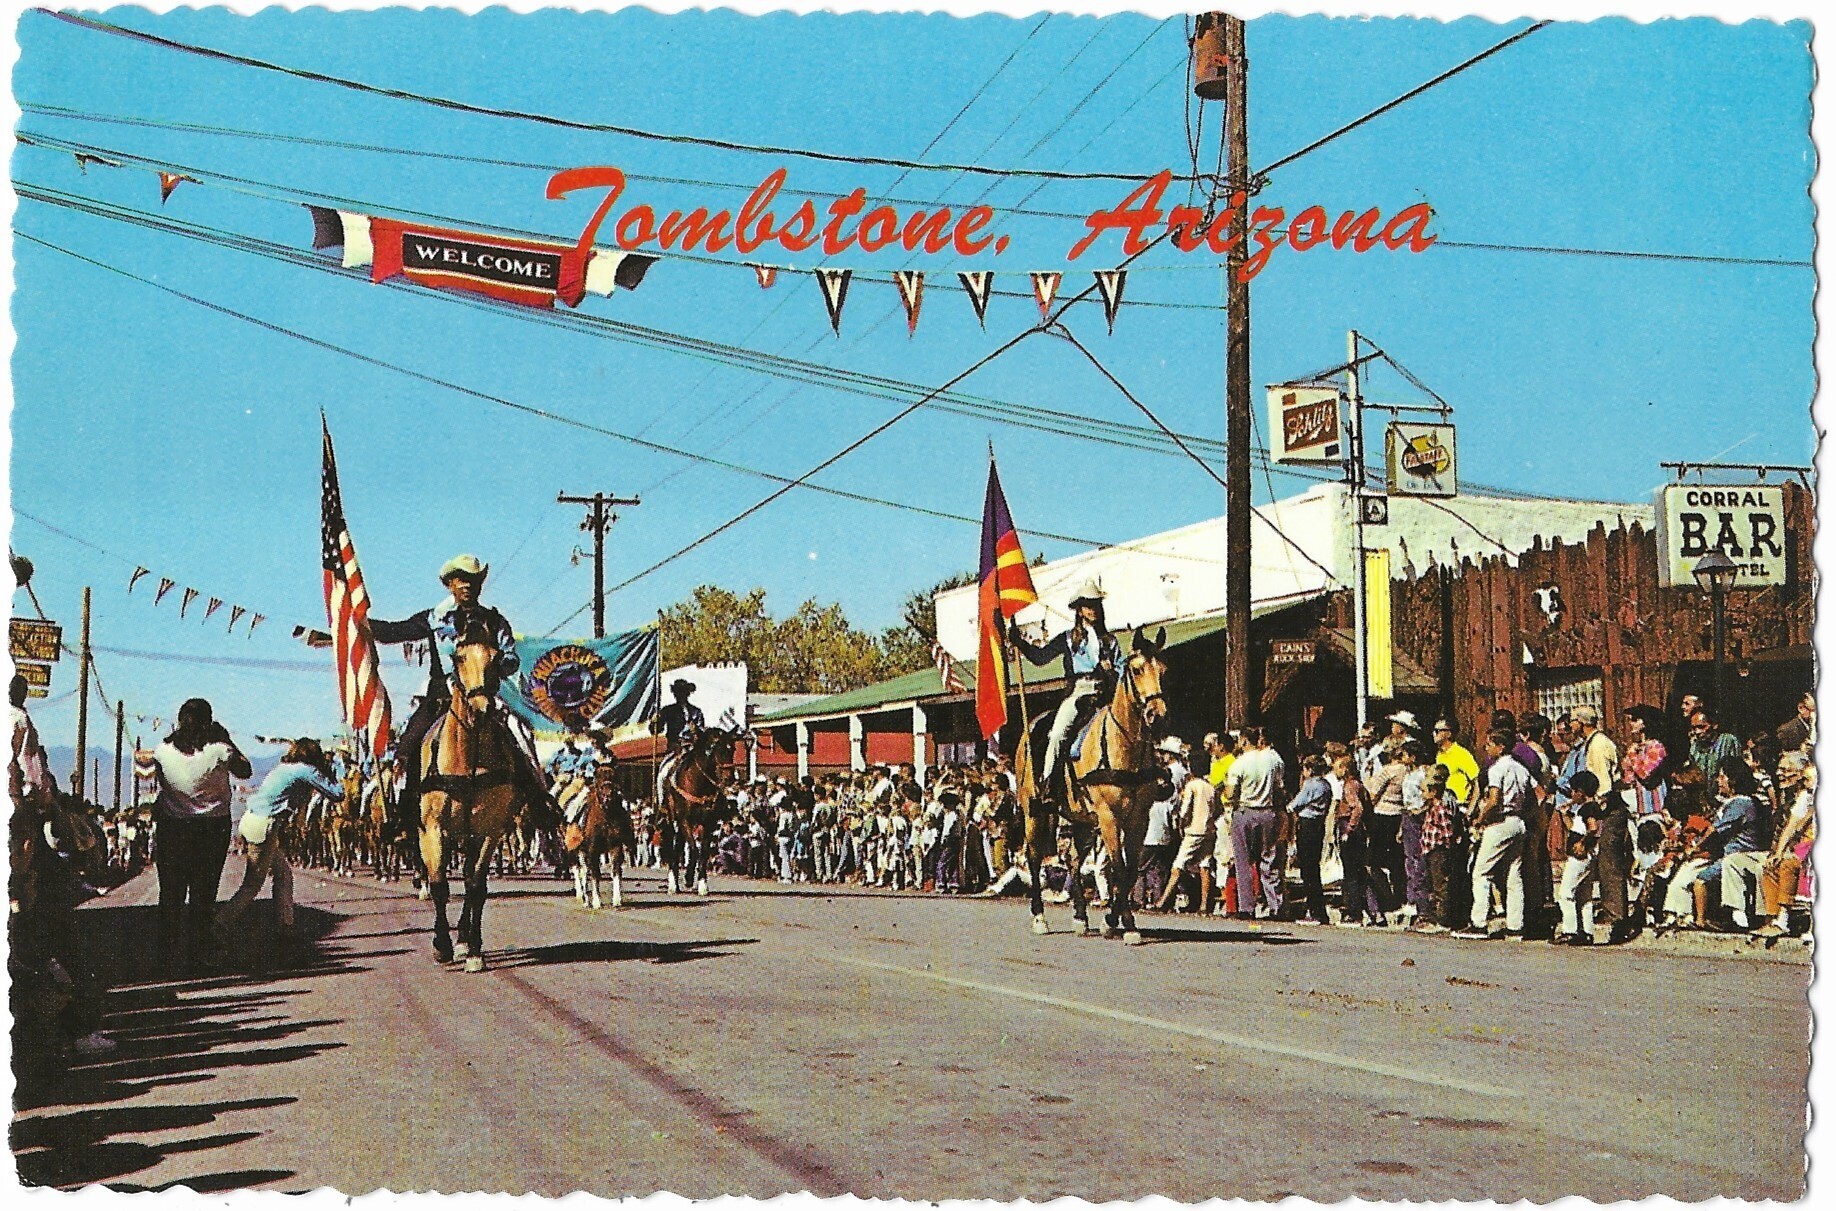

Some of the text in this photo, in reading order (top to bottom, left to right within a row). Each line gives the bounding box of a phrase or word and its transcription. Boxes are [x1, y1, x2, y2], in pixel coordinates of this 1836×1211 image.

[415, 244, 550, 278] WELCOME
[1286, 403, 1334, 445] Schlitz
[1686, 491, 1770, 507] CORRAL
[1679, 512, 1782, 558] BAR
